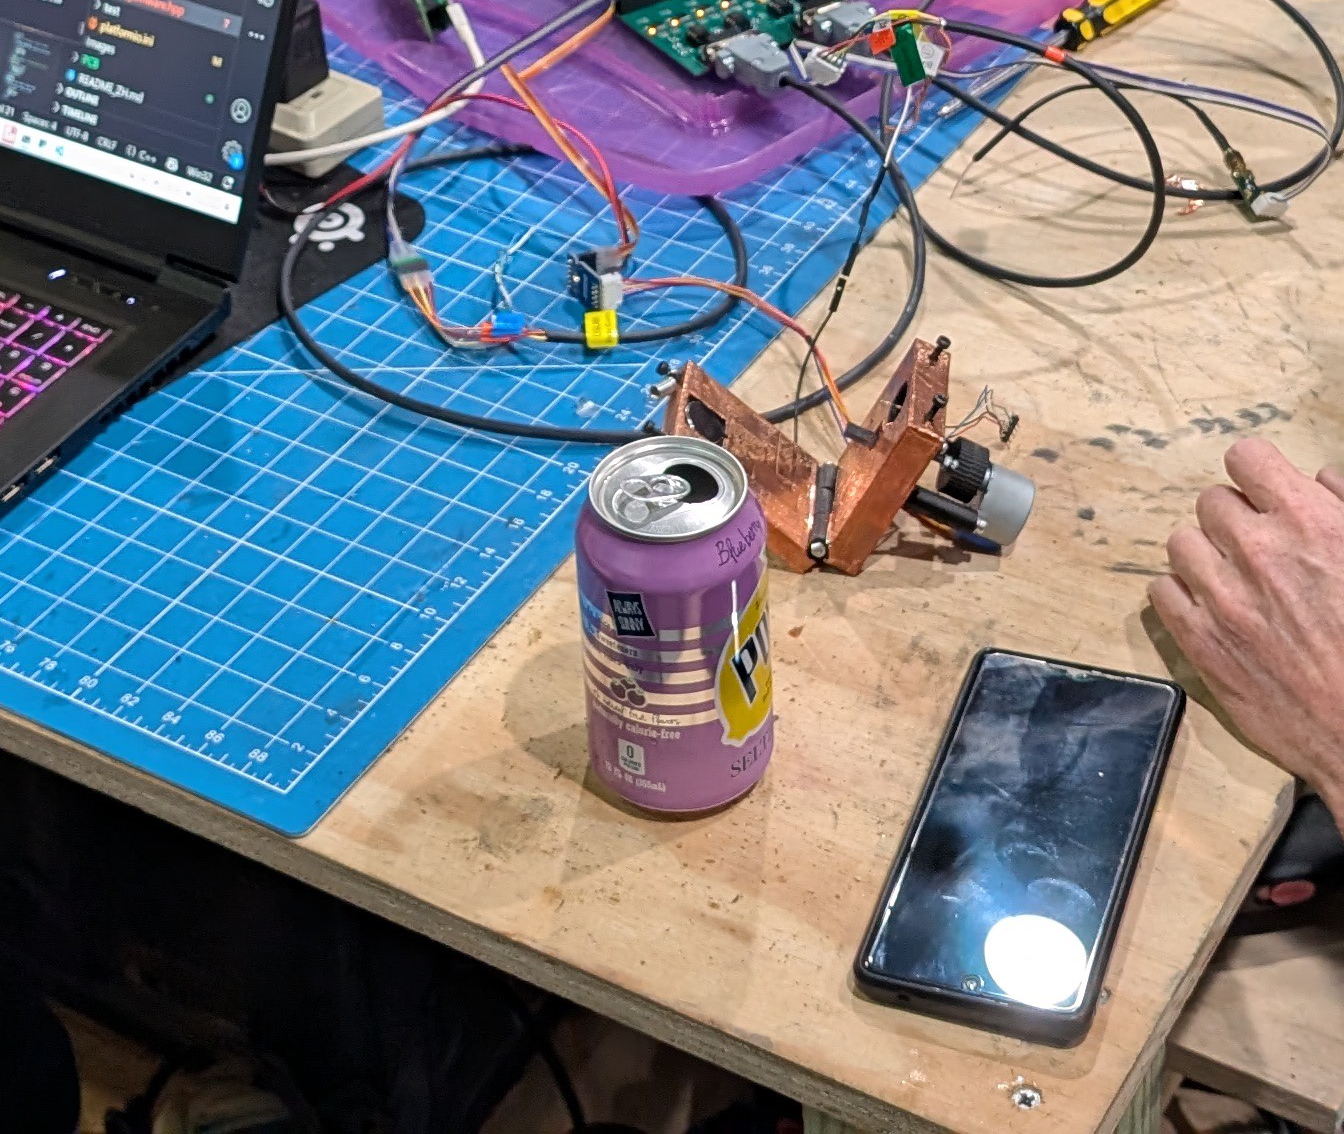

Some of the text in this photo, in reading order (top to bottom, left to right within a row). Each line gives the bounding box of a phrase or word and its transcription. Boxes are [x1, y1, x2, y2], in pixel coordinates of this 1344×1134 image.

[97, 20, 155, 49] platformio.ini
[63, 86, 99, 106] OUTLINE
[59, 104, 98, 126] TIMELINE
[63, 124, 89, 142] UTF-8
[137, 149, 157, 164] C++
[185, 165, 213, 183] Win32
[561, 461, 581, 475] 20
[715, 519, 762, 566] Blueberry
[479, 546, 497, 559] 14
[450, 575, 468, 589] 12
[419, 606, 437, 619] 10
[0, 641, 16, 655] 76
[390, 640, 404, 650] 8
[39, 657, 58, 671] 78
[78, 675, 98, 689] 80
[358, 673, 372, 684] 6
[120, 692, 140, 707] 82
[161, 711, 182, 725] 84
[326, 708, 338, 717] 4
[205, 729, 226, 744] 86
[626, 722, 680, 739] calorie-free
[291, 742, 305, 753] 2
[626, 745, 635, 759] 0
[248, 748, 269, 763] 88
